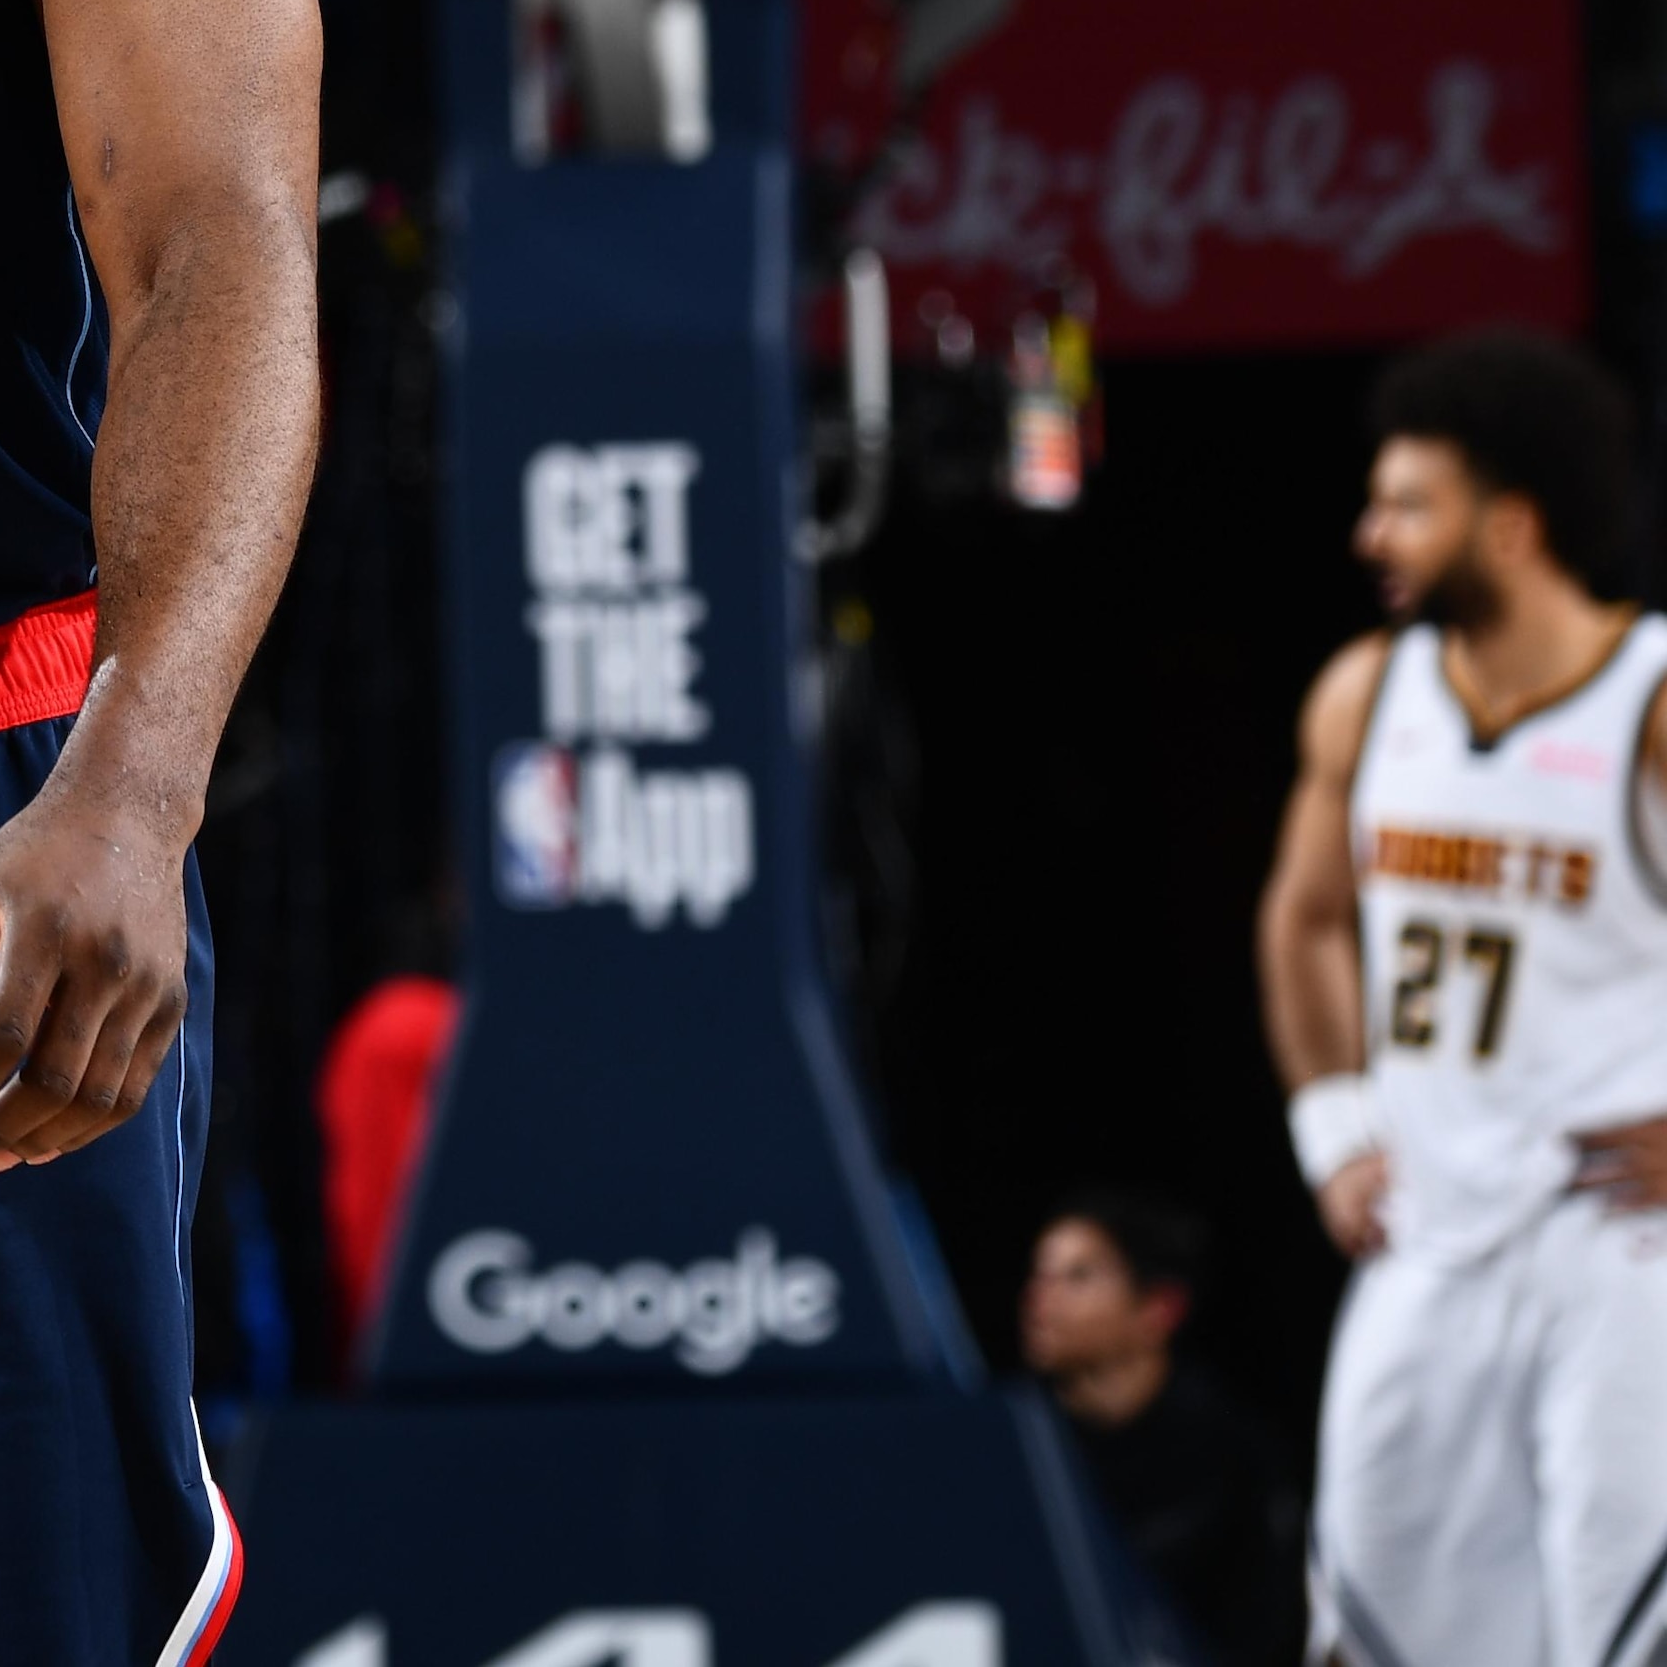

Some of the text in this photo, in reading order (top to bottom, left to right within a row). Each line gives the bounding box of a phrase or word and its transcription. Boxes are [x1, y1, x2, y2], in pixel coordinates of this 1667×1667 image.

[523, 440, 699, 590] GET
[529, 596, 712, 742] THE
[577, 751, 753, 929] App
[1389, 918, 1519, 1062] 27
[428, 1224, 841, 1376] Google
